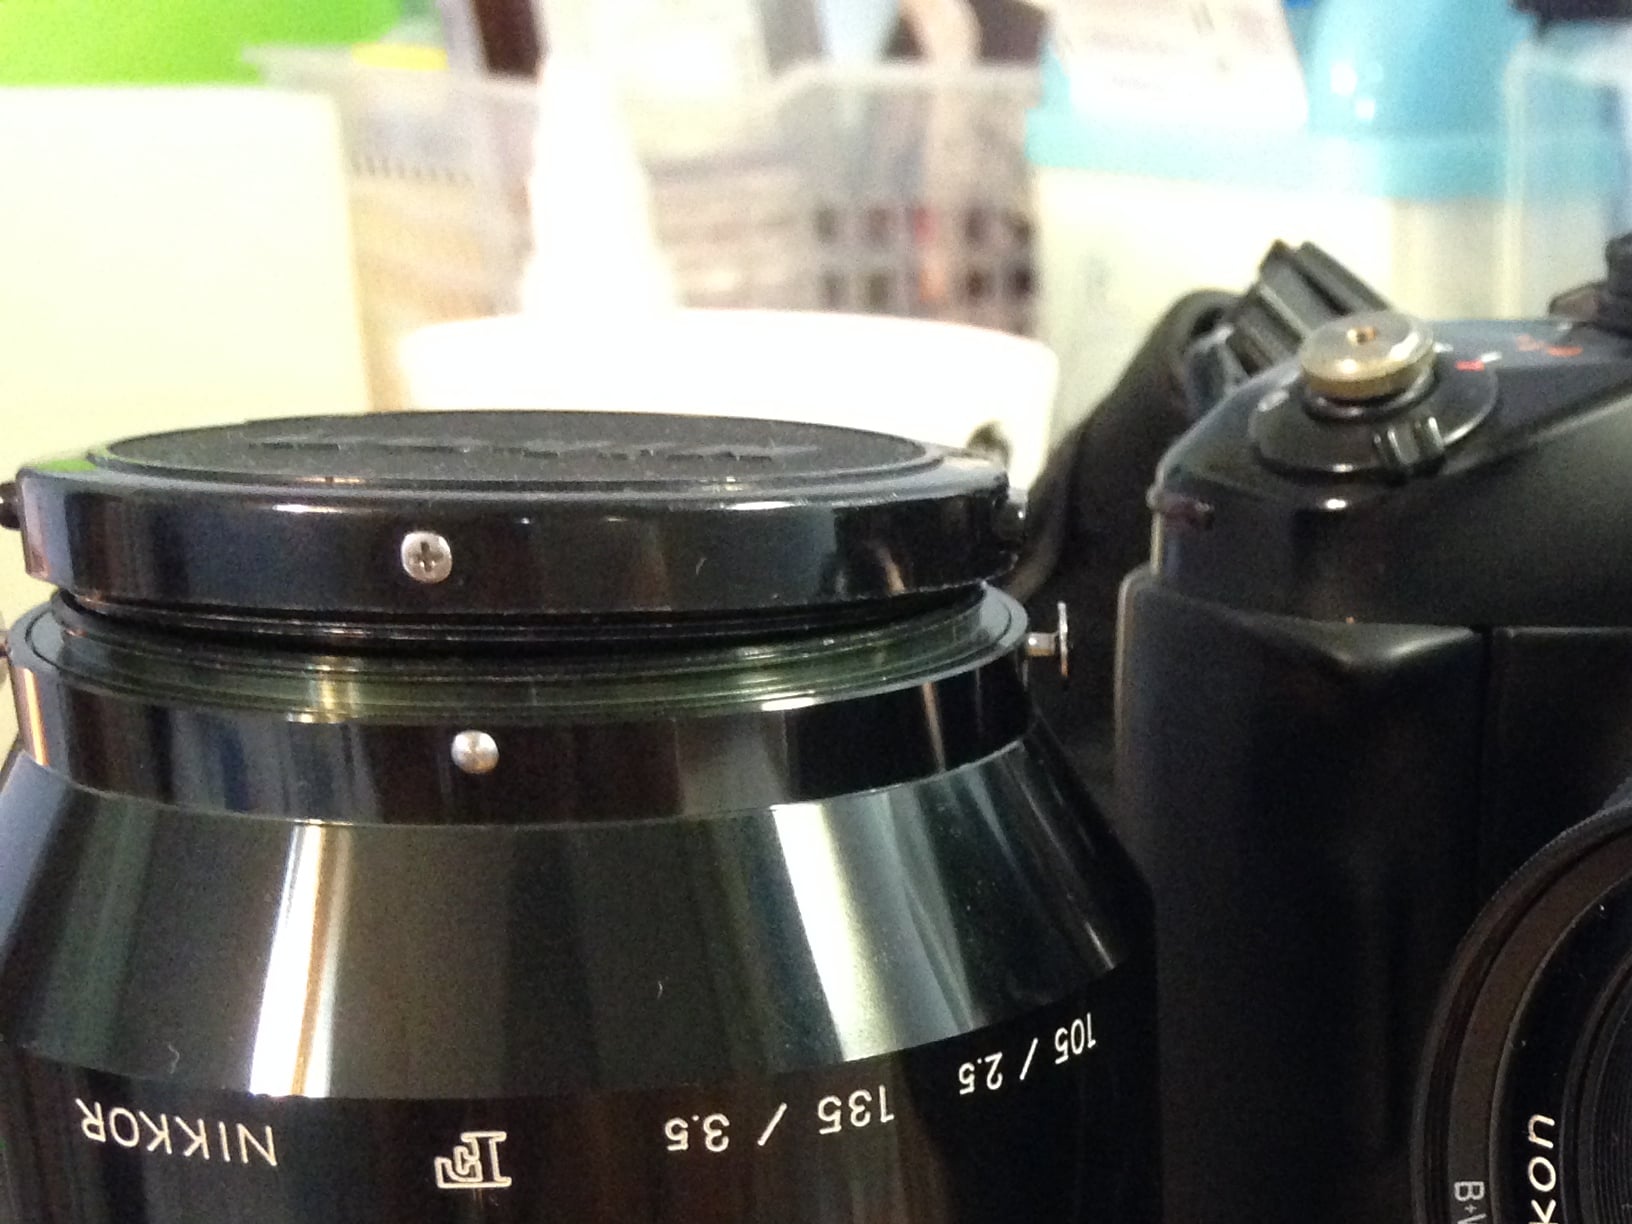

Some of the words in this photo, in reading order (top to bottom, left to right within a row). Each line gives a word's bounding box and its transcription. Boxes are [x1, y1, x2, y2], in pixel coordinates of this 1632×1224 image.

[1018, 1037, 1039, 1081] /
[1053, 1012, 1097, 1065] 105
[957, 1051, 1004, 1095] 2.5
[757, 1102, 788, 1147] /
[816, 1084, 896, 1135] 135
[75, 1098, 278, 1167] NIKKOR
[664, 1112, 731, 1153] 3.5
